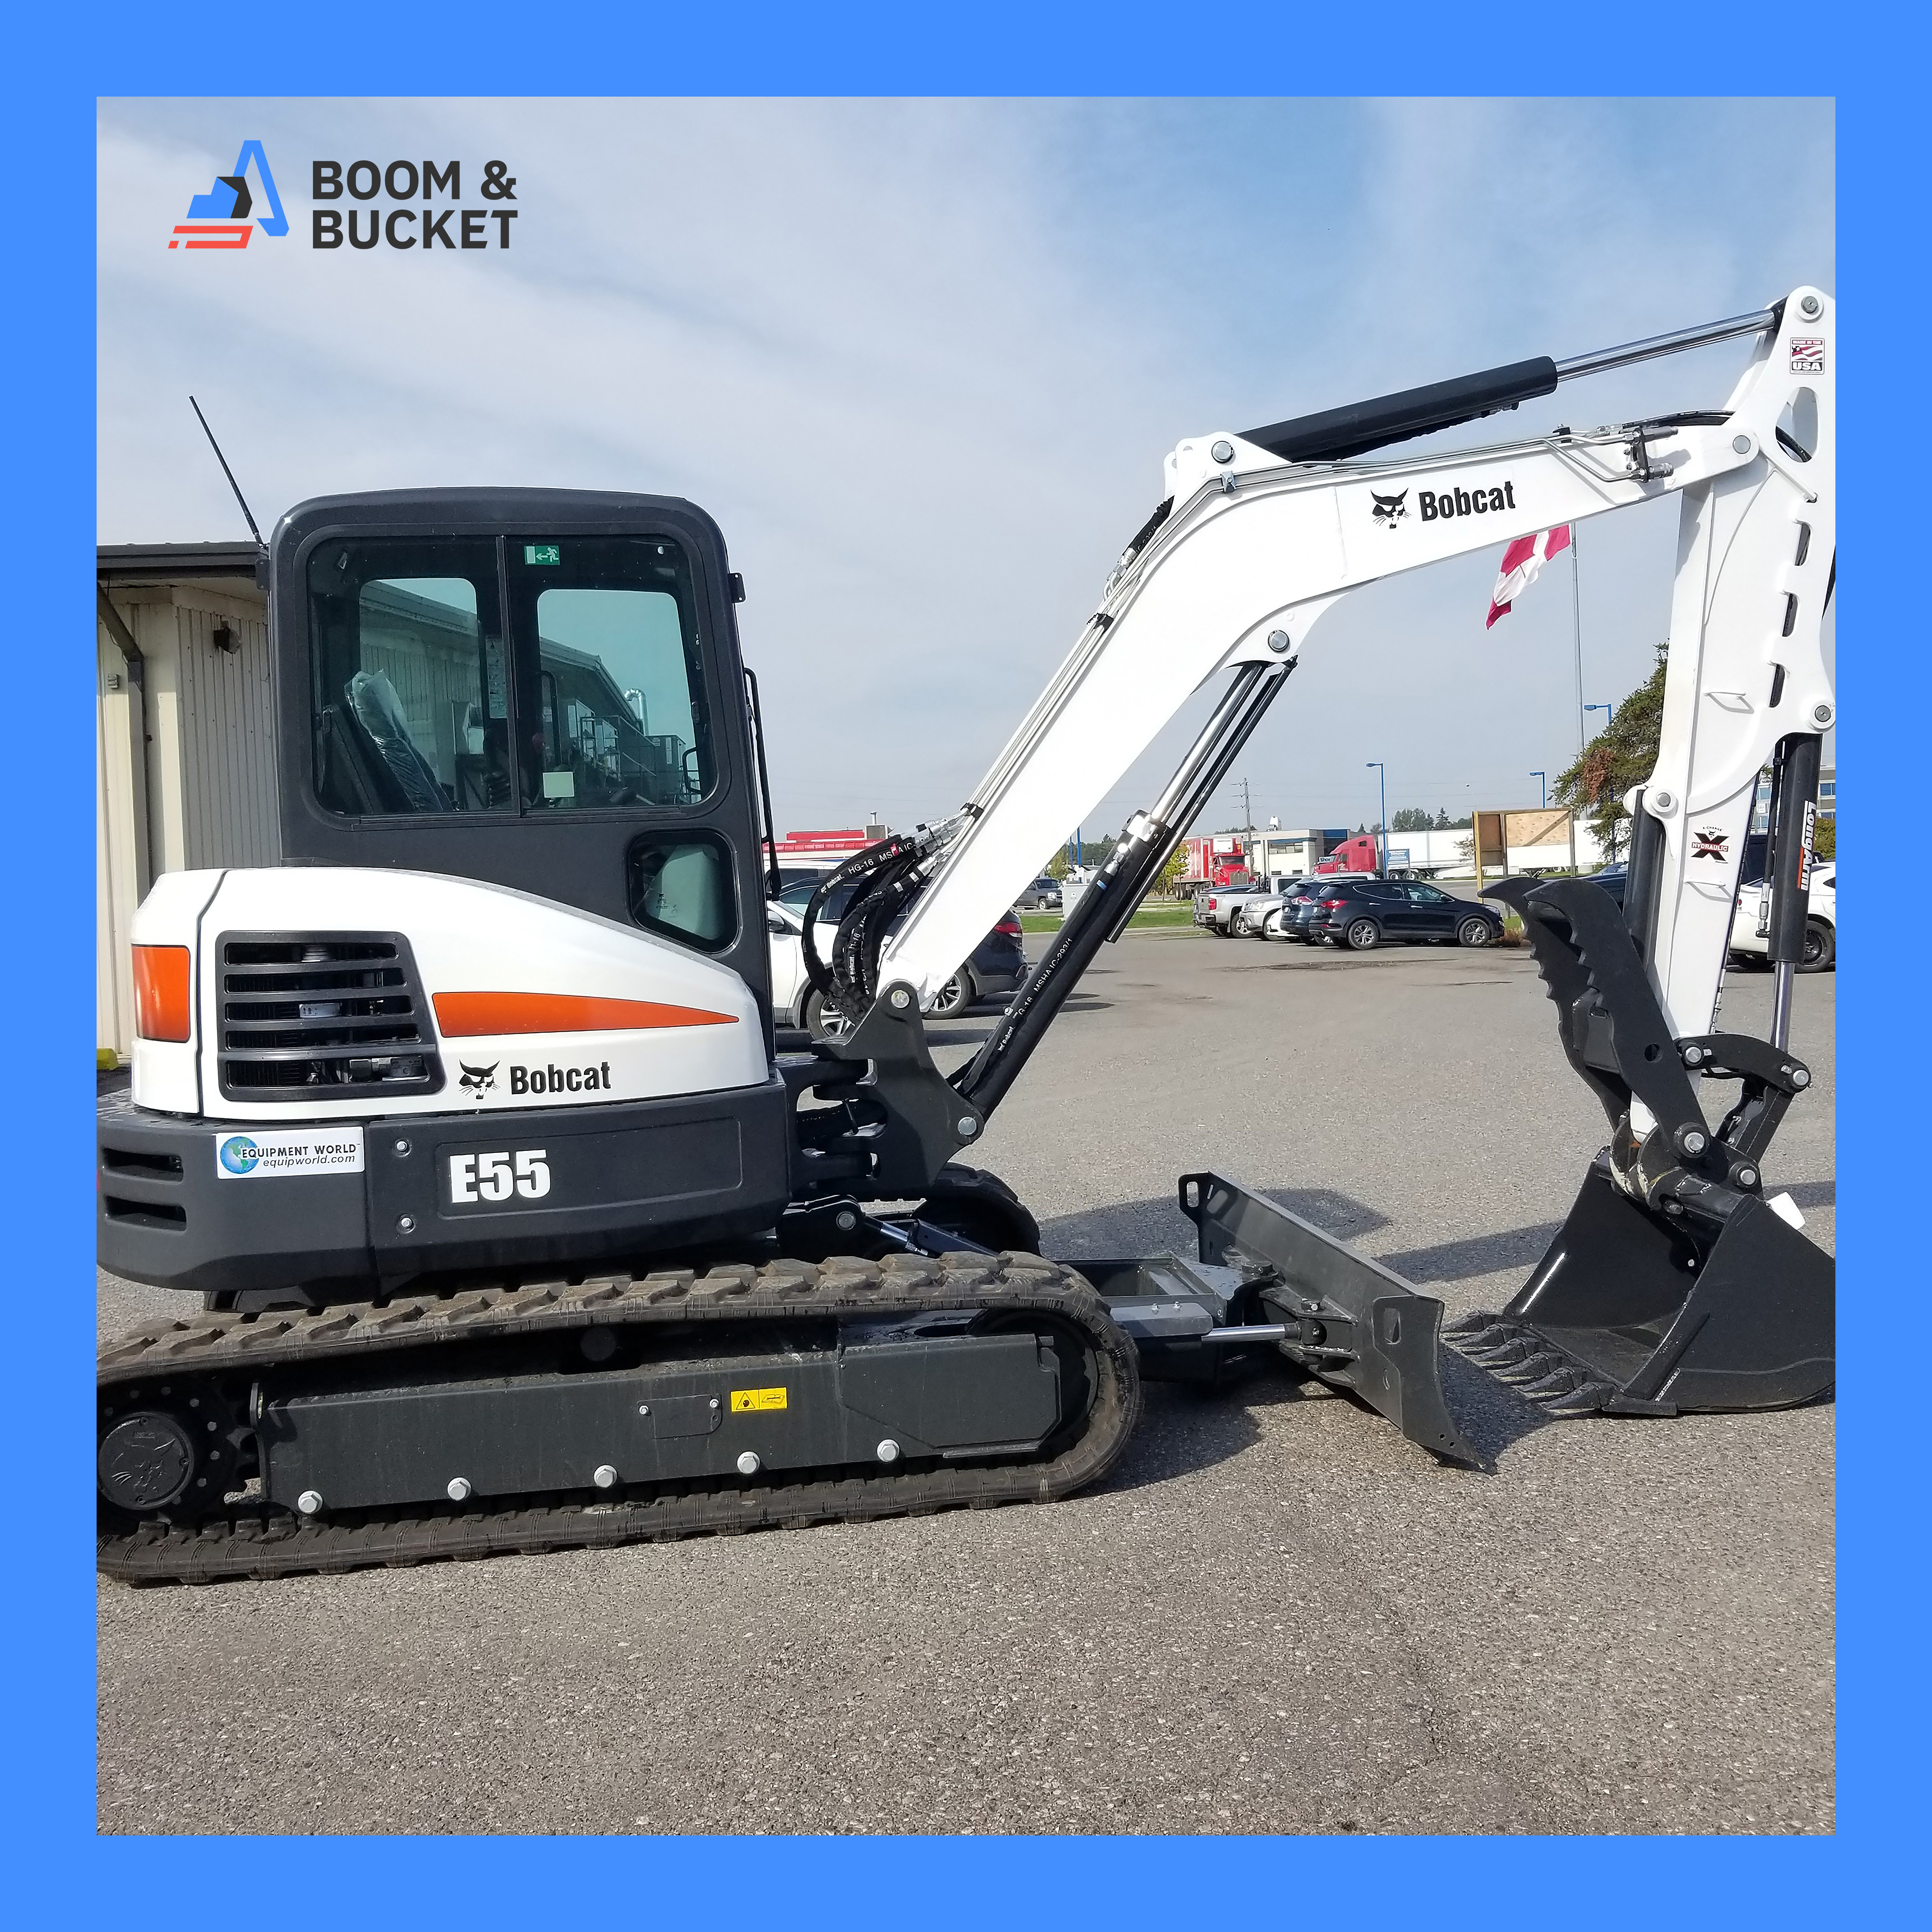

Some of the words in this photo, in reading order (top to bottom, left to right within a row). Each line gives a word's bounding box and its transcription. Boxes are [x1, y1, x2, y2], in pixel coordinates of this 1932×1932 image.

[1792, 362, 1821, 370] USA
[1419, 481, 1516, 522] Bobcat
[1692, 842, 1728, 852] HYDRAULIC
[1801, 801, 1817, 891] LongArm
[848, 858, 874, 875] HG-16
[878, 846, 904, 862] MSA
[1033, 969, 1052, 992] MSHA
[510, 1061, 611, 1095] Bobcat
[242, 1146, 309, 1158] EQUIPMENT
[314, 1144, 356, 1154] WORLD
[263, 1155, 355, 1168] equipworld.com
[450, 1149, 551, 1203] E55
